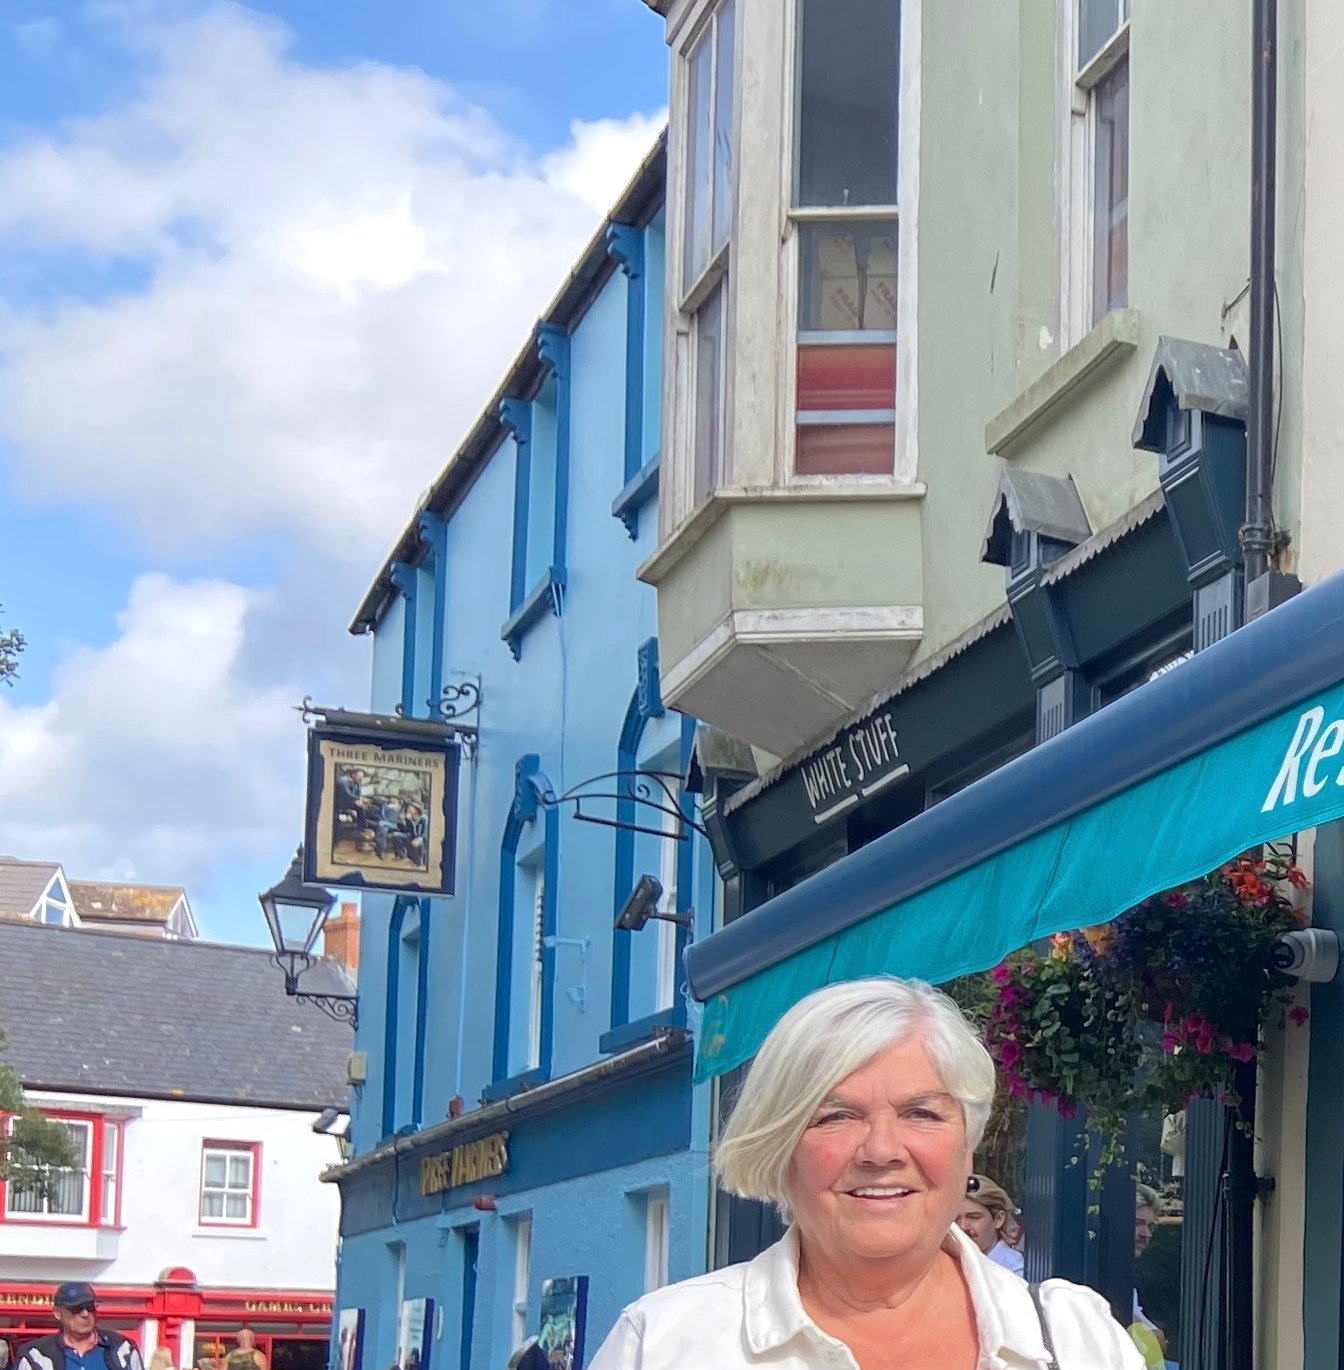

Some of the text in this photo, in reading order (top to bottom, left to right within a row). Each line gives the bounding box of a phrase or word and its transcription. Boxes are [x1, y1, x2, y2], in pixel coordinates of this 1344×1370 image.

[328, 746, 440, 769] THREE MARINERS
[800, 713, 899, 809] WHITE STUFF
